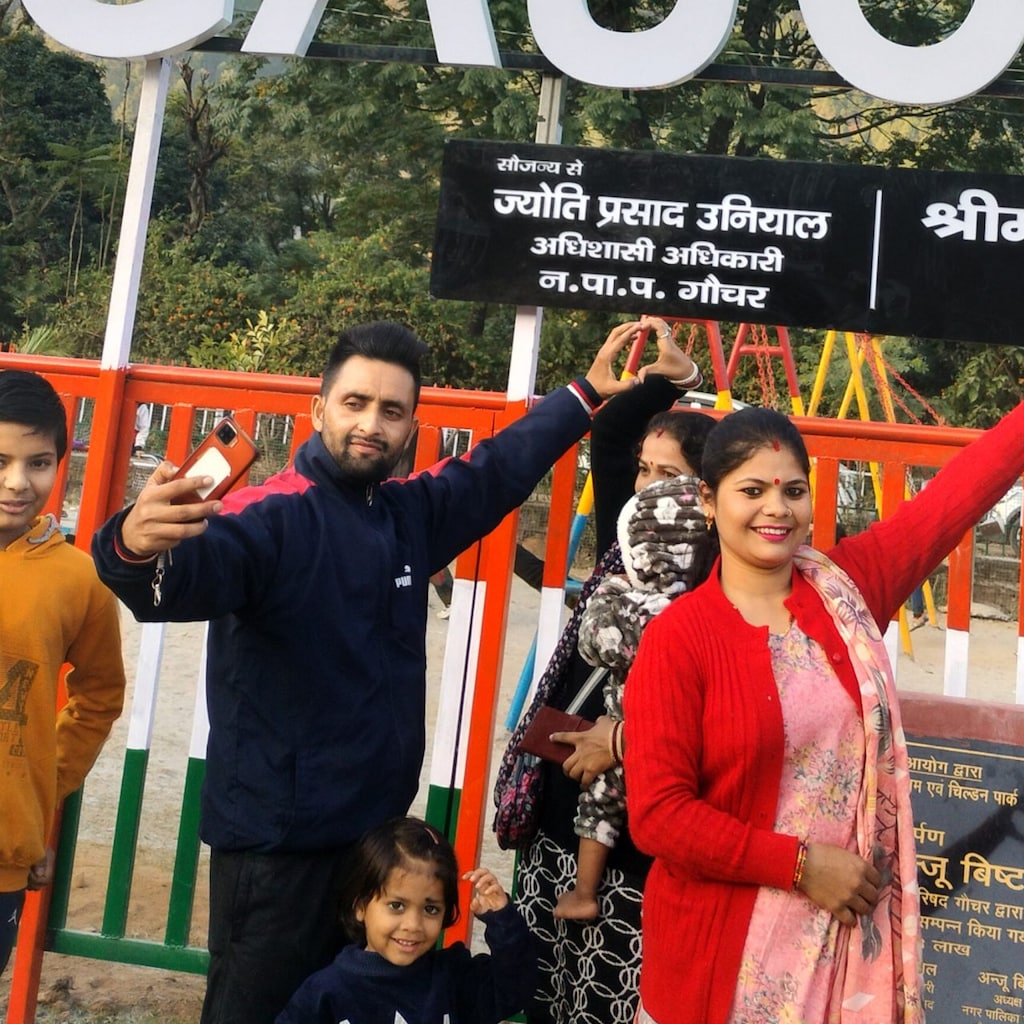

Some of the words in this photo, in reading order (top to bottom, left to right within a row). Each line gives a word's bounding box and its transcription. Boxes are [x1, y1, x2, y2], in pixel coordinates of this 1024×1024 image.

[496, 156, 561, 175] सौजन्य
[565, 159, 584, 176] से
[493, 181, 590, 221] ज्योति
[594, 194, 689, 228] प्रसाद
[695, 194, 832, 240] उनियाल
[530, 231, 655, 262] अधिशासी
[661, 242, 785, 272] अधिकारी
[677, 273, 771, 309] गौचर
[953, 763, 983, 779] द्वारा
[993, 788, 1019, 807] पार्क
[954, 893, 991, 915] गौचर
[994, 902, 1024, 920] द्वारा
[967, 918, 1002, 941] किया
[931, 940, 971, 956] लाख
[977, 971, 1010, 992] अन्जू
